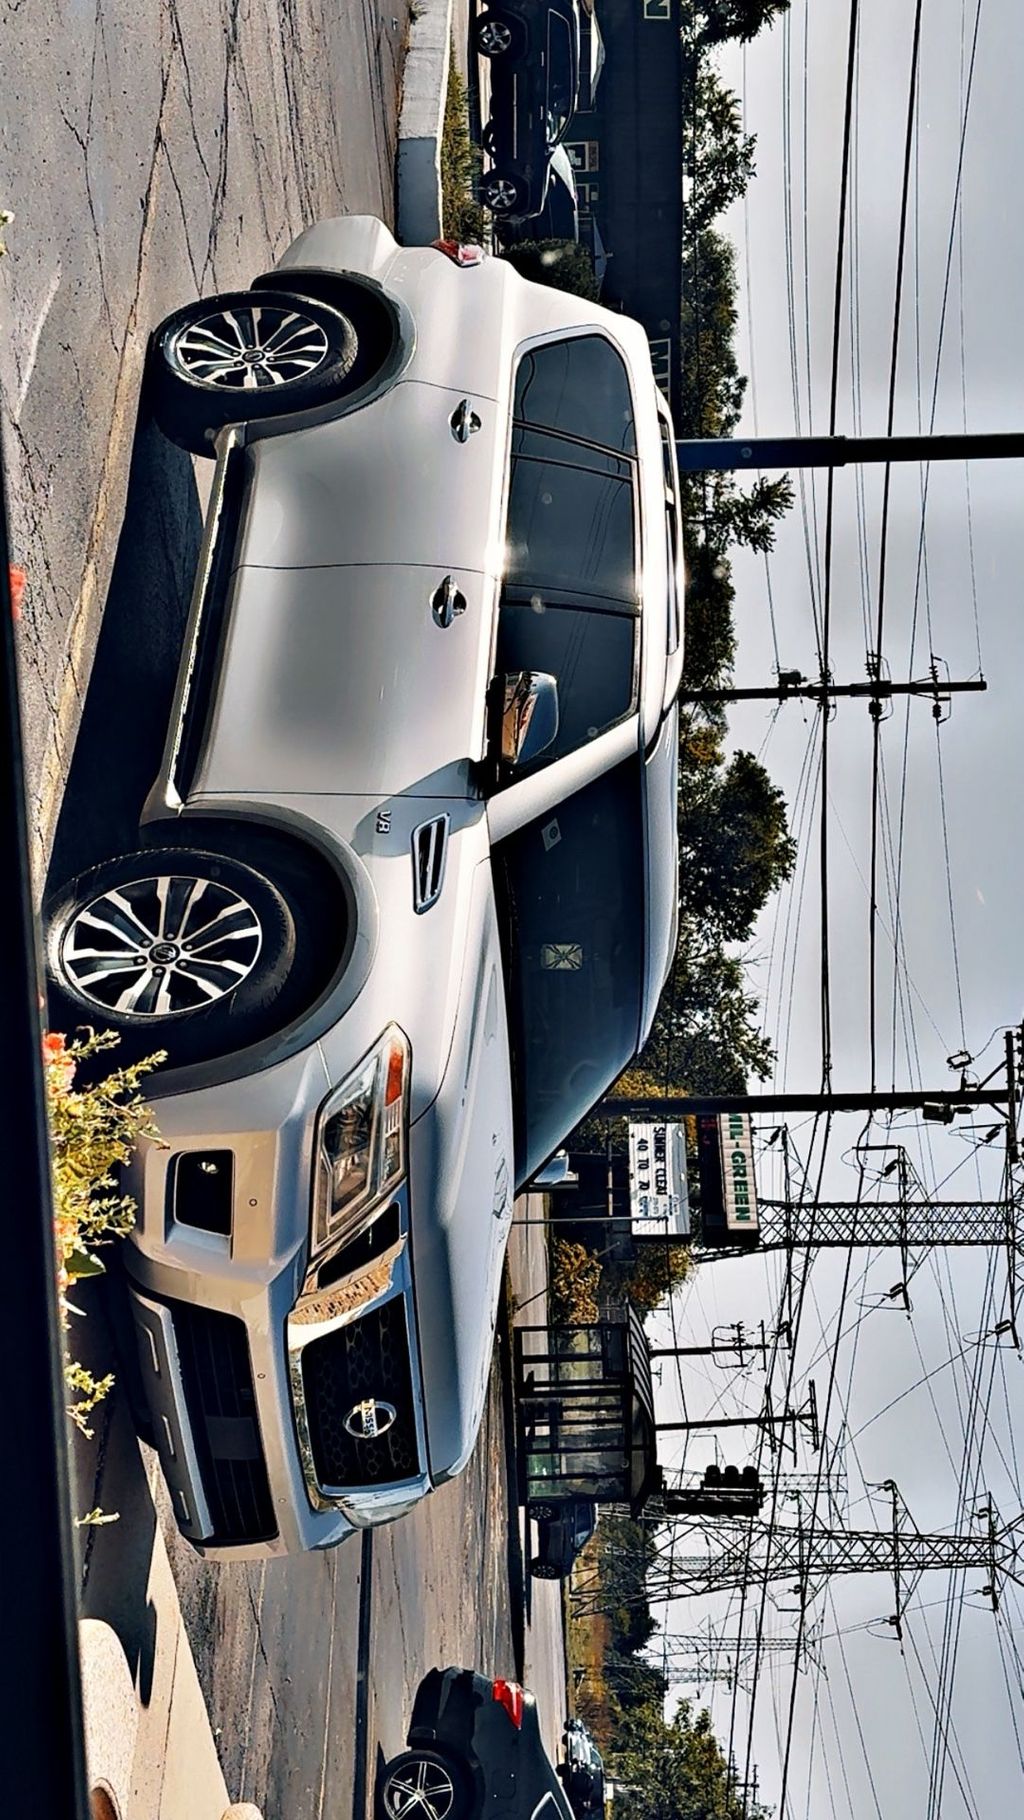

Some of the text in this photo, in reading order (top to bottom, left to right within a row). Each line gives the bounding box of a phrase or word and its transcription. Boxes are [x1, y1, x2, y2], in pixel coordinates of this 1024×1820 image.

[376, 810, 392, 834] V8
[653, 1126, 667, 1163] SUMMER
[637, 1138, 650, 1191] 40 TO 70
